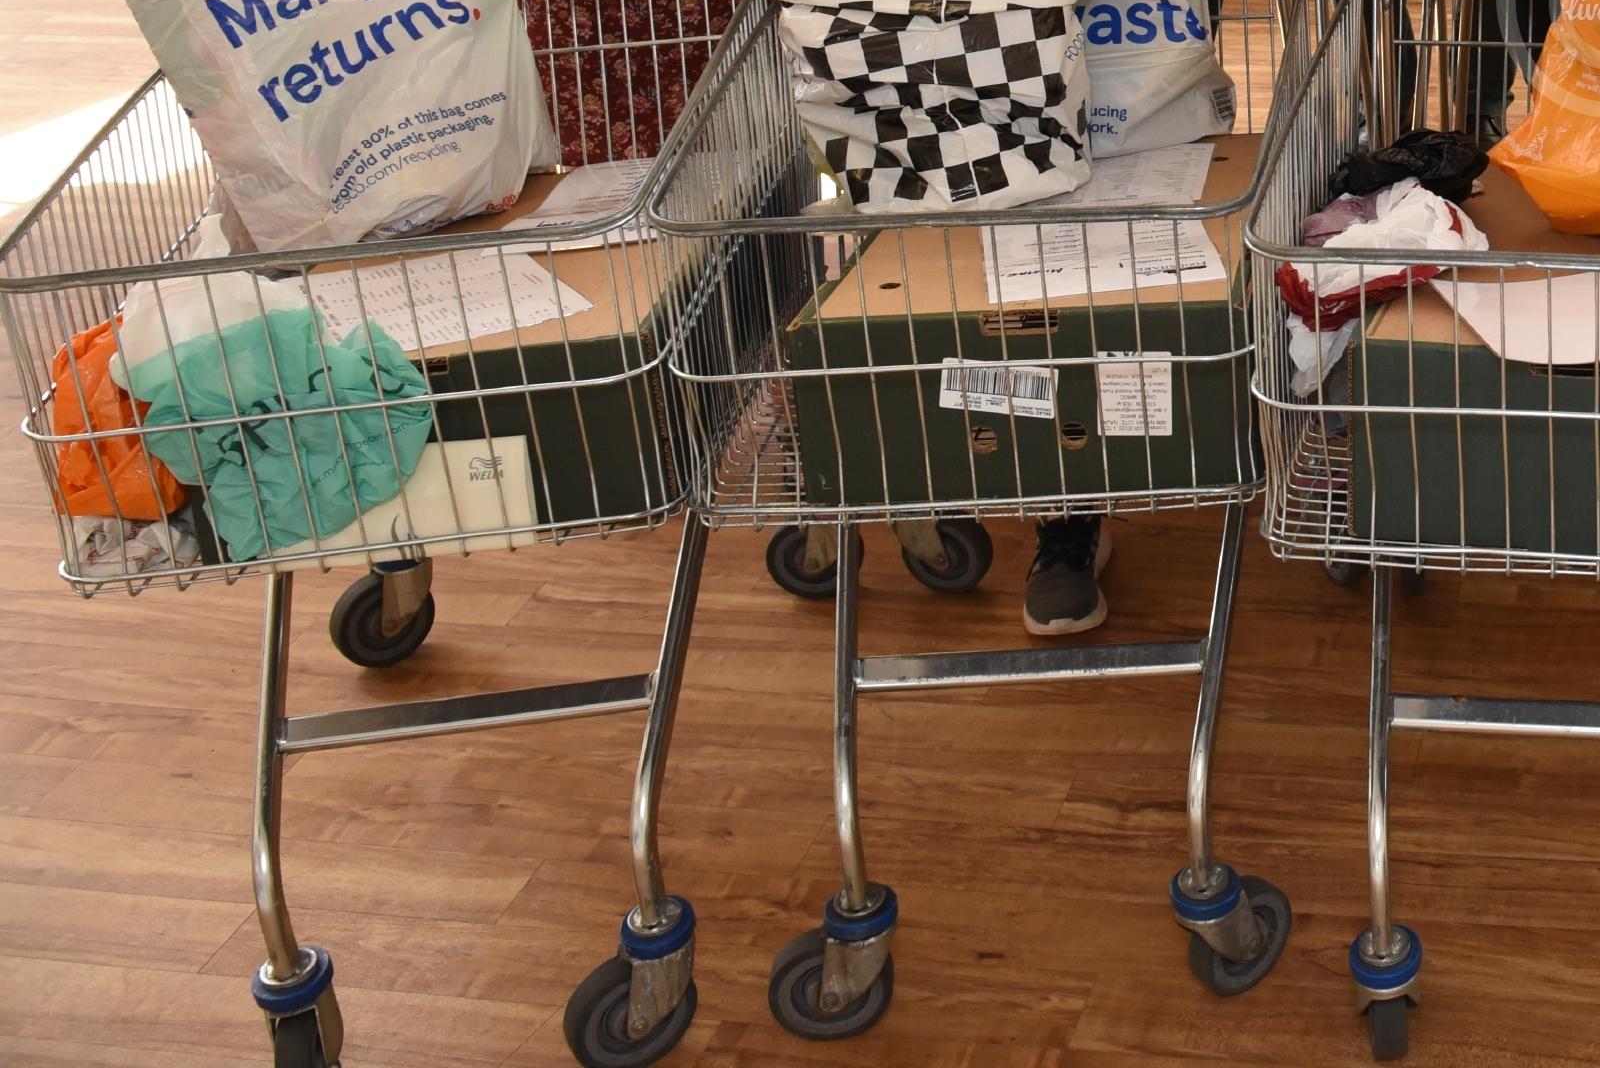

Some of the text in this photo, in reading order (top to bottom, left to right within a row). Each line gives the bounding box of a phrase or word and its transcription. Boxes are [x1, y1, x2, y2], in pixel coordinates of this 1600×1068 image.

[361, 125, 395, 150] 80%
[398, 116, 413, 131] of
[414, 109, 439, 125] this
[438, 103, 466, 120] bag
[464, 91, 507, 112] comes
[1090, 106, 1127, 122] ucing
[355, 154, 378, 176] old
[379, 131, 426, 162] plastic
[427, 113, 496, 142] packaging.
